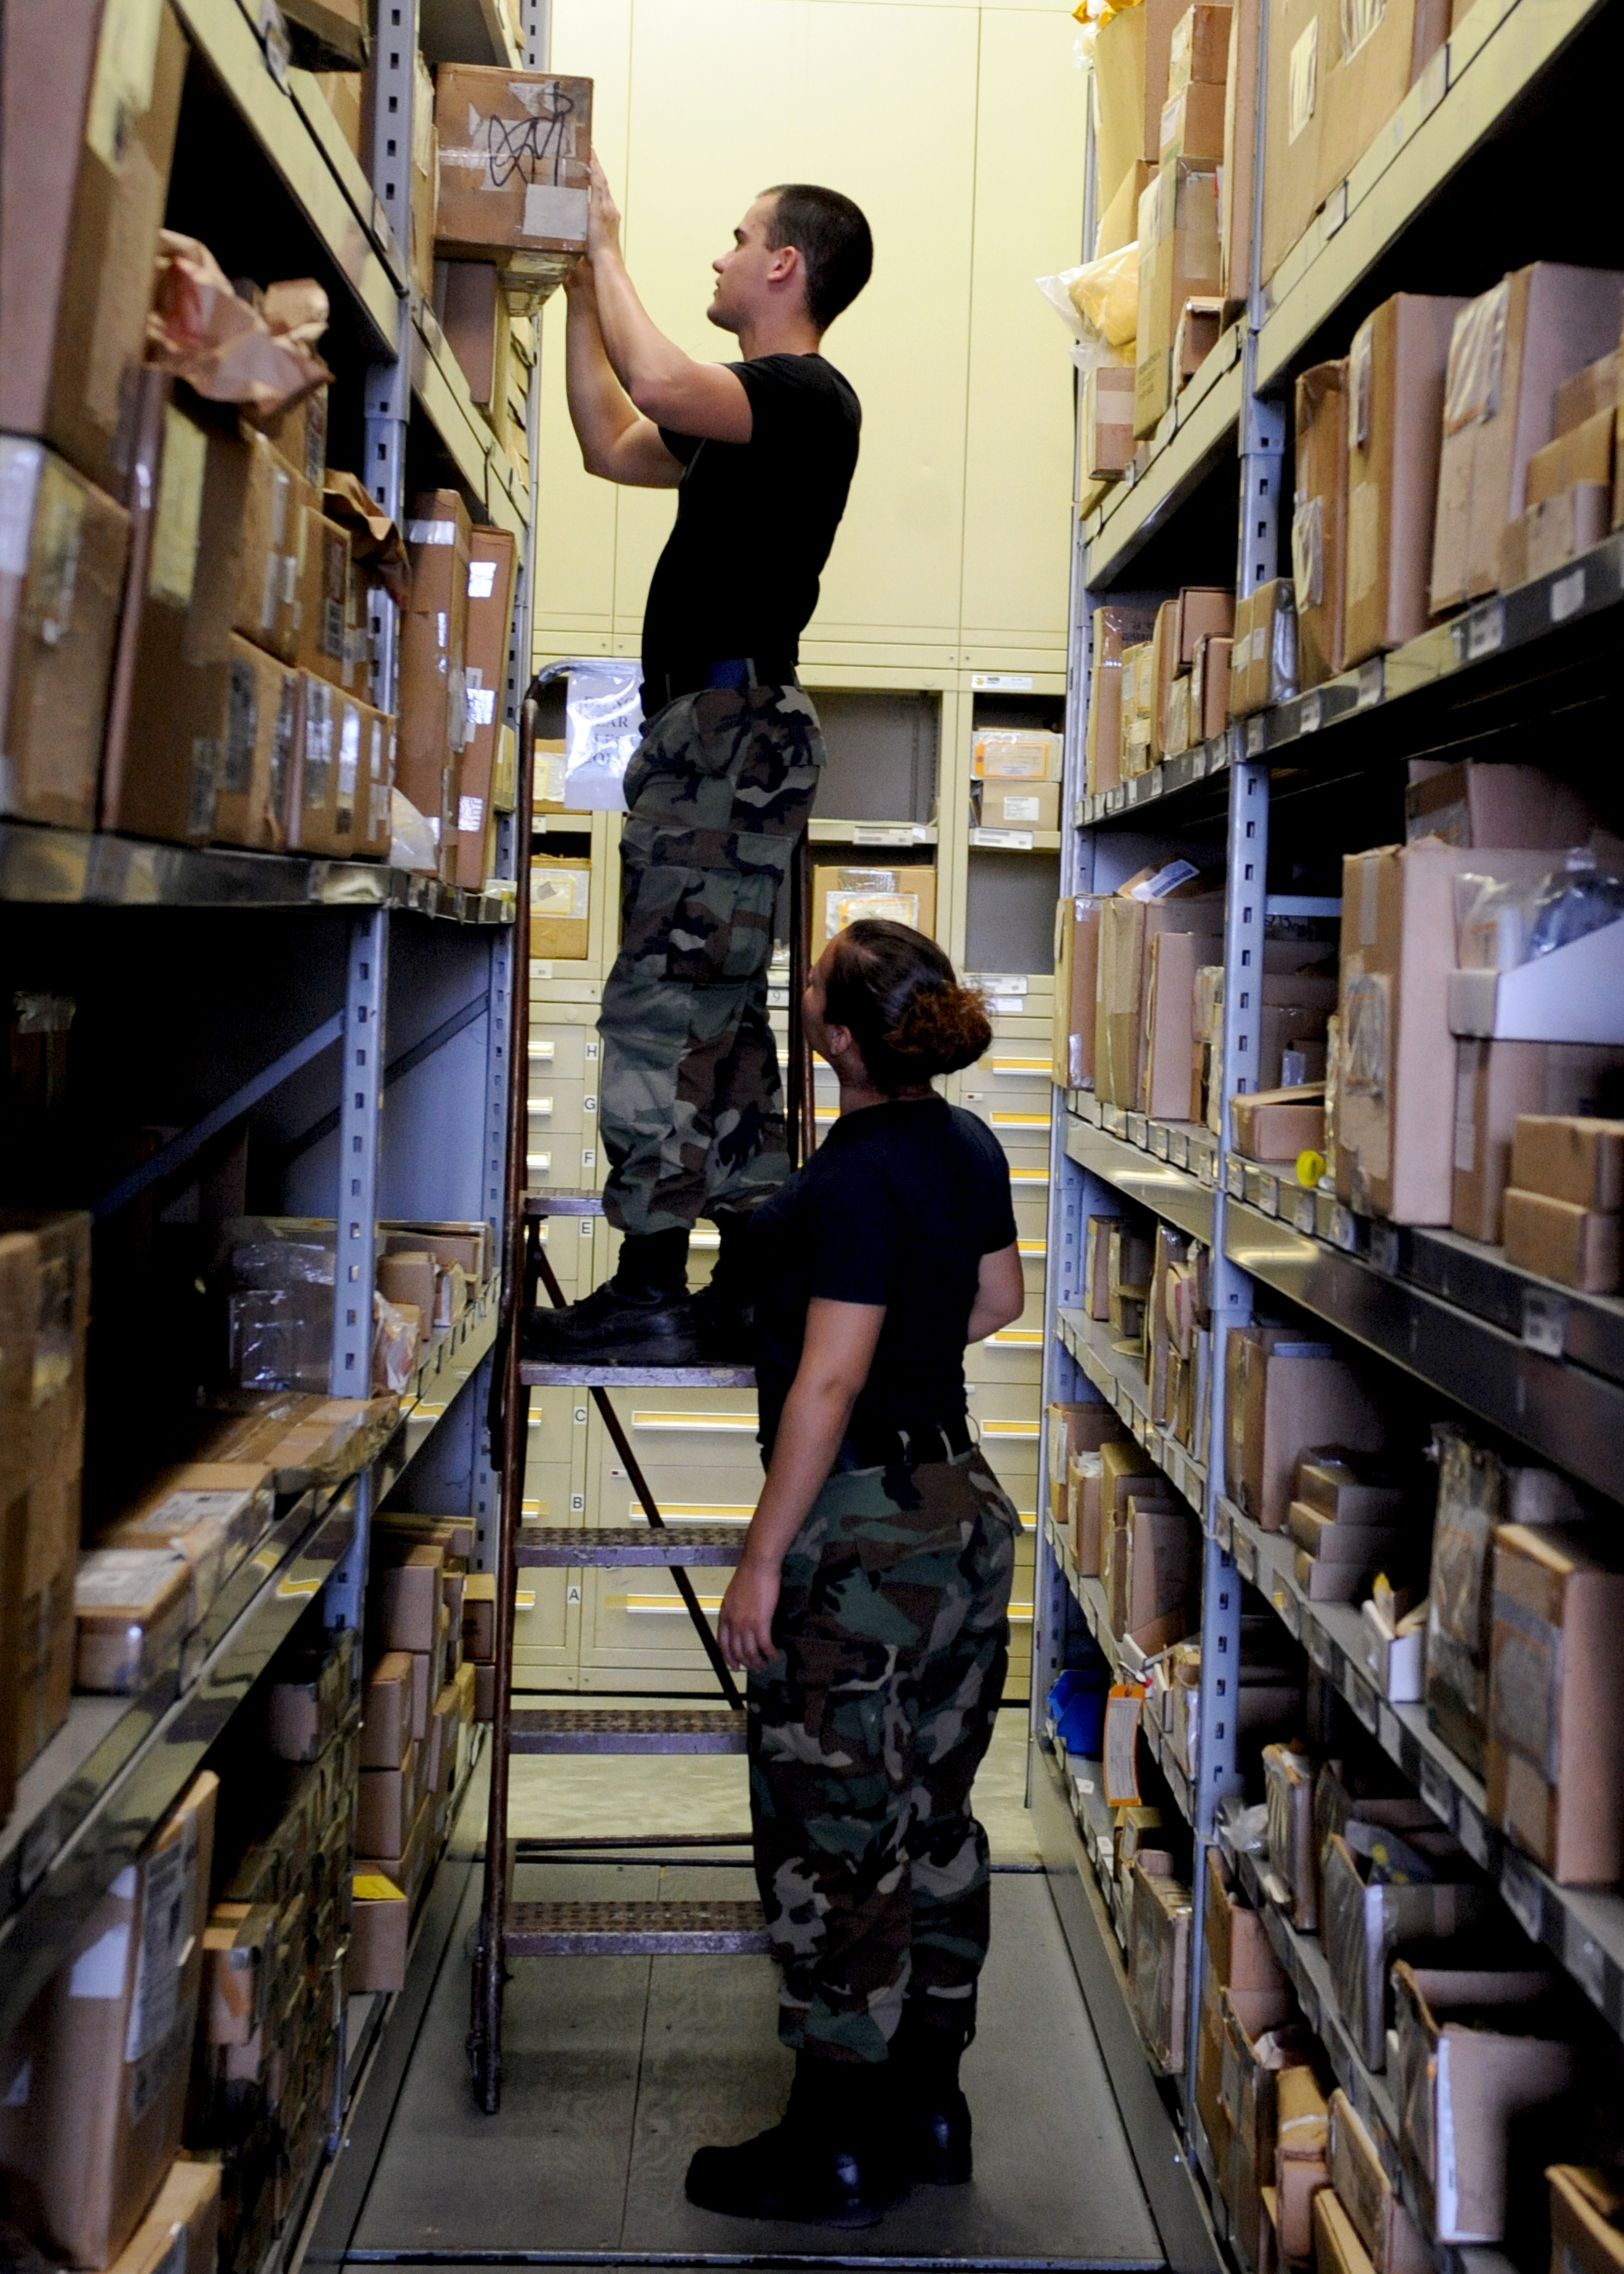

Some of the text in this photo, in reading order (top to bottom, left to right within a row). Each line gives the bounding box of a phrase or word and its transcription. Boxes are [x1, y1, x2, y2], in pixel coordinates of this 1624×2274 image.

[587, 1045, 597, 1057] H
[584, 1098, 596, 1111] G
[584, 1152, 594, 1163] F
[581, 1222, 592, 1234] E
[575, 1409, 587, 1421] C
[573, 1497, 583, 1508] B
[569, 1588, 580, 1600] A
